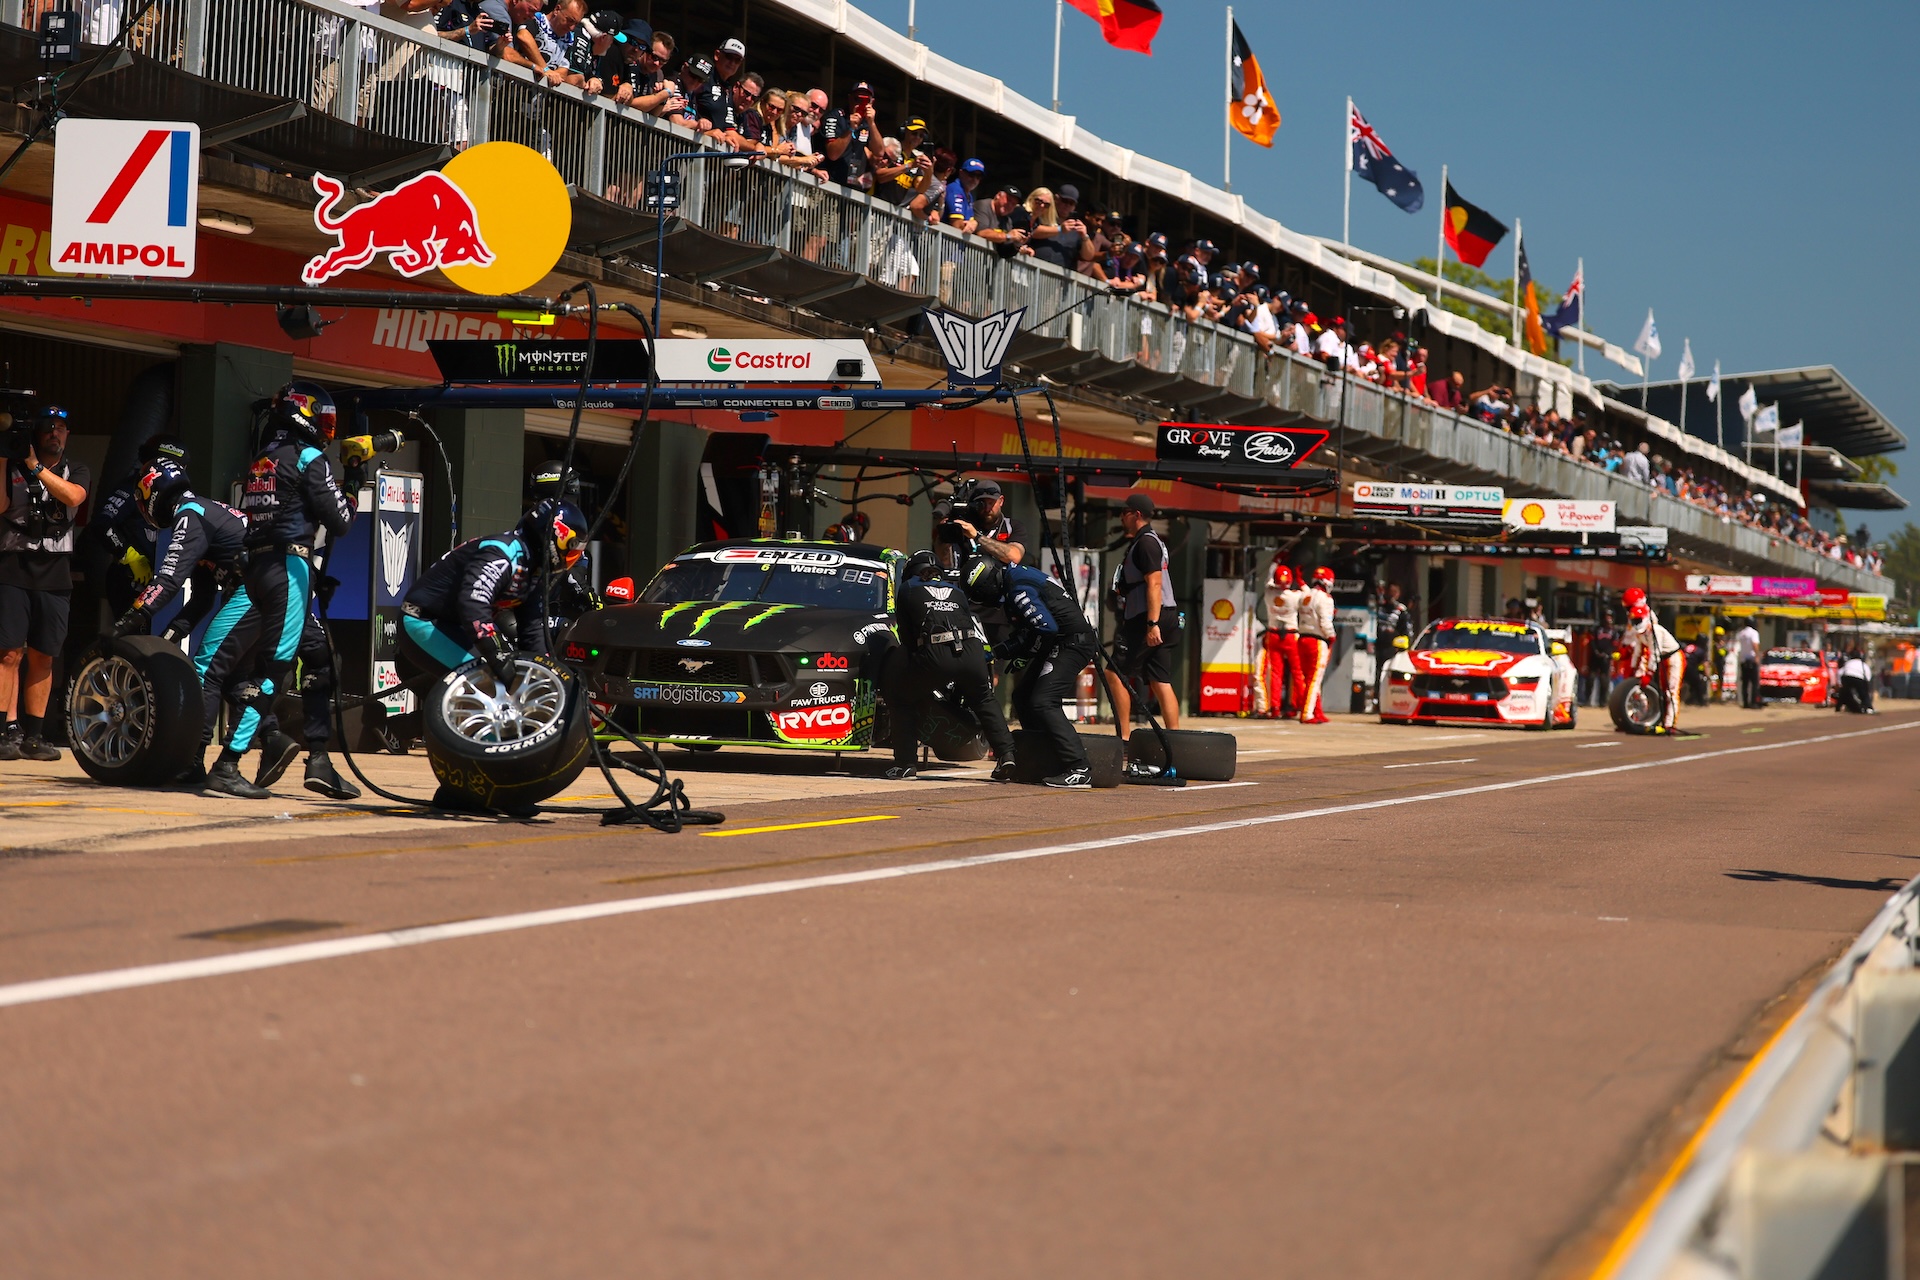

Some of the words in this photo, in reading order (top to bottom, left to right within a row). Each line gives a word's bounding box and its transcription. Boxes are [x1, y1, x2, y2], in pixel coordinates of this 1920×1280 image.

[58, 242, 185, 267] AMPOL
[519, 350, 588, 364] MONSTER
[735, 351, 811, 369] Castrol
[723, 399, 793, 407] CONNECTED
[1167, 429, 1231, 446] GROVE
[1198, 445, 1230, 459] Racing
[1247, 436, 1290, 458] Gates
[246, 494, 279, 506] MPOL
[1401, 488, 1433, 499] Mobil
[1455, 491, 1500, 501] OPTUS
[1558, 512, 1604, 521] V-Power
[758, 551, 832, 562] ENZED
[760, 563, 770, 571] 6
[790, 565, 837, 575] Waters
[566, 642, 586, 659] dba
[817, 652, 848, 669] dba
[791, 698, 812, 707] FAW
[814, 694, 845, 705] TRUCKS
[144, 681, 156, 749] DUNLOP
[778, 707, 850, 730] RYCO
[485, 727, 557, 753] DUNLOP
